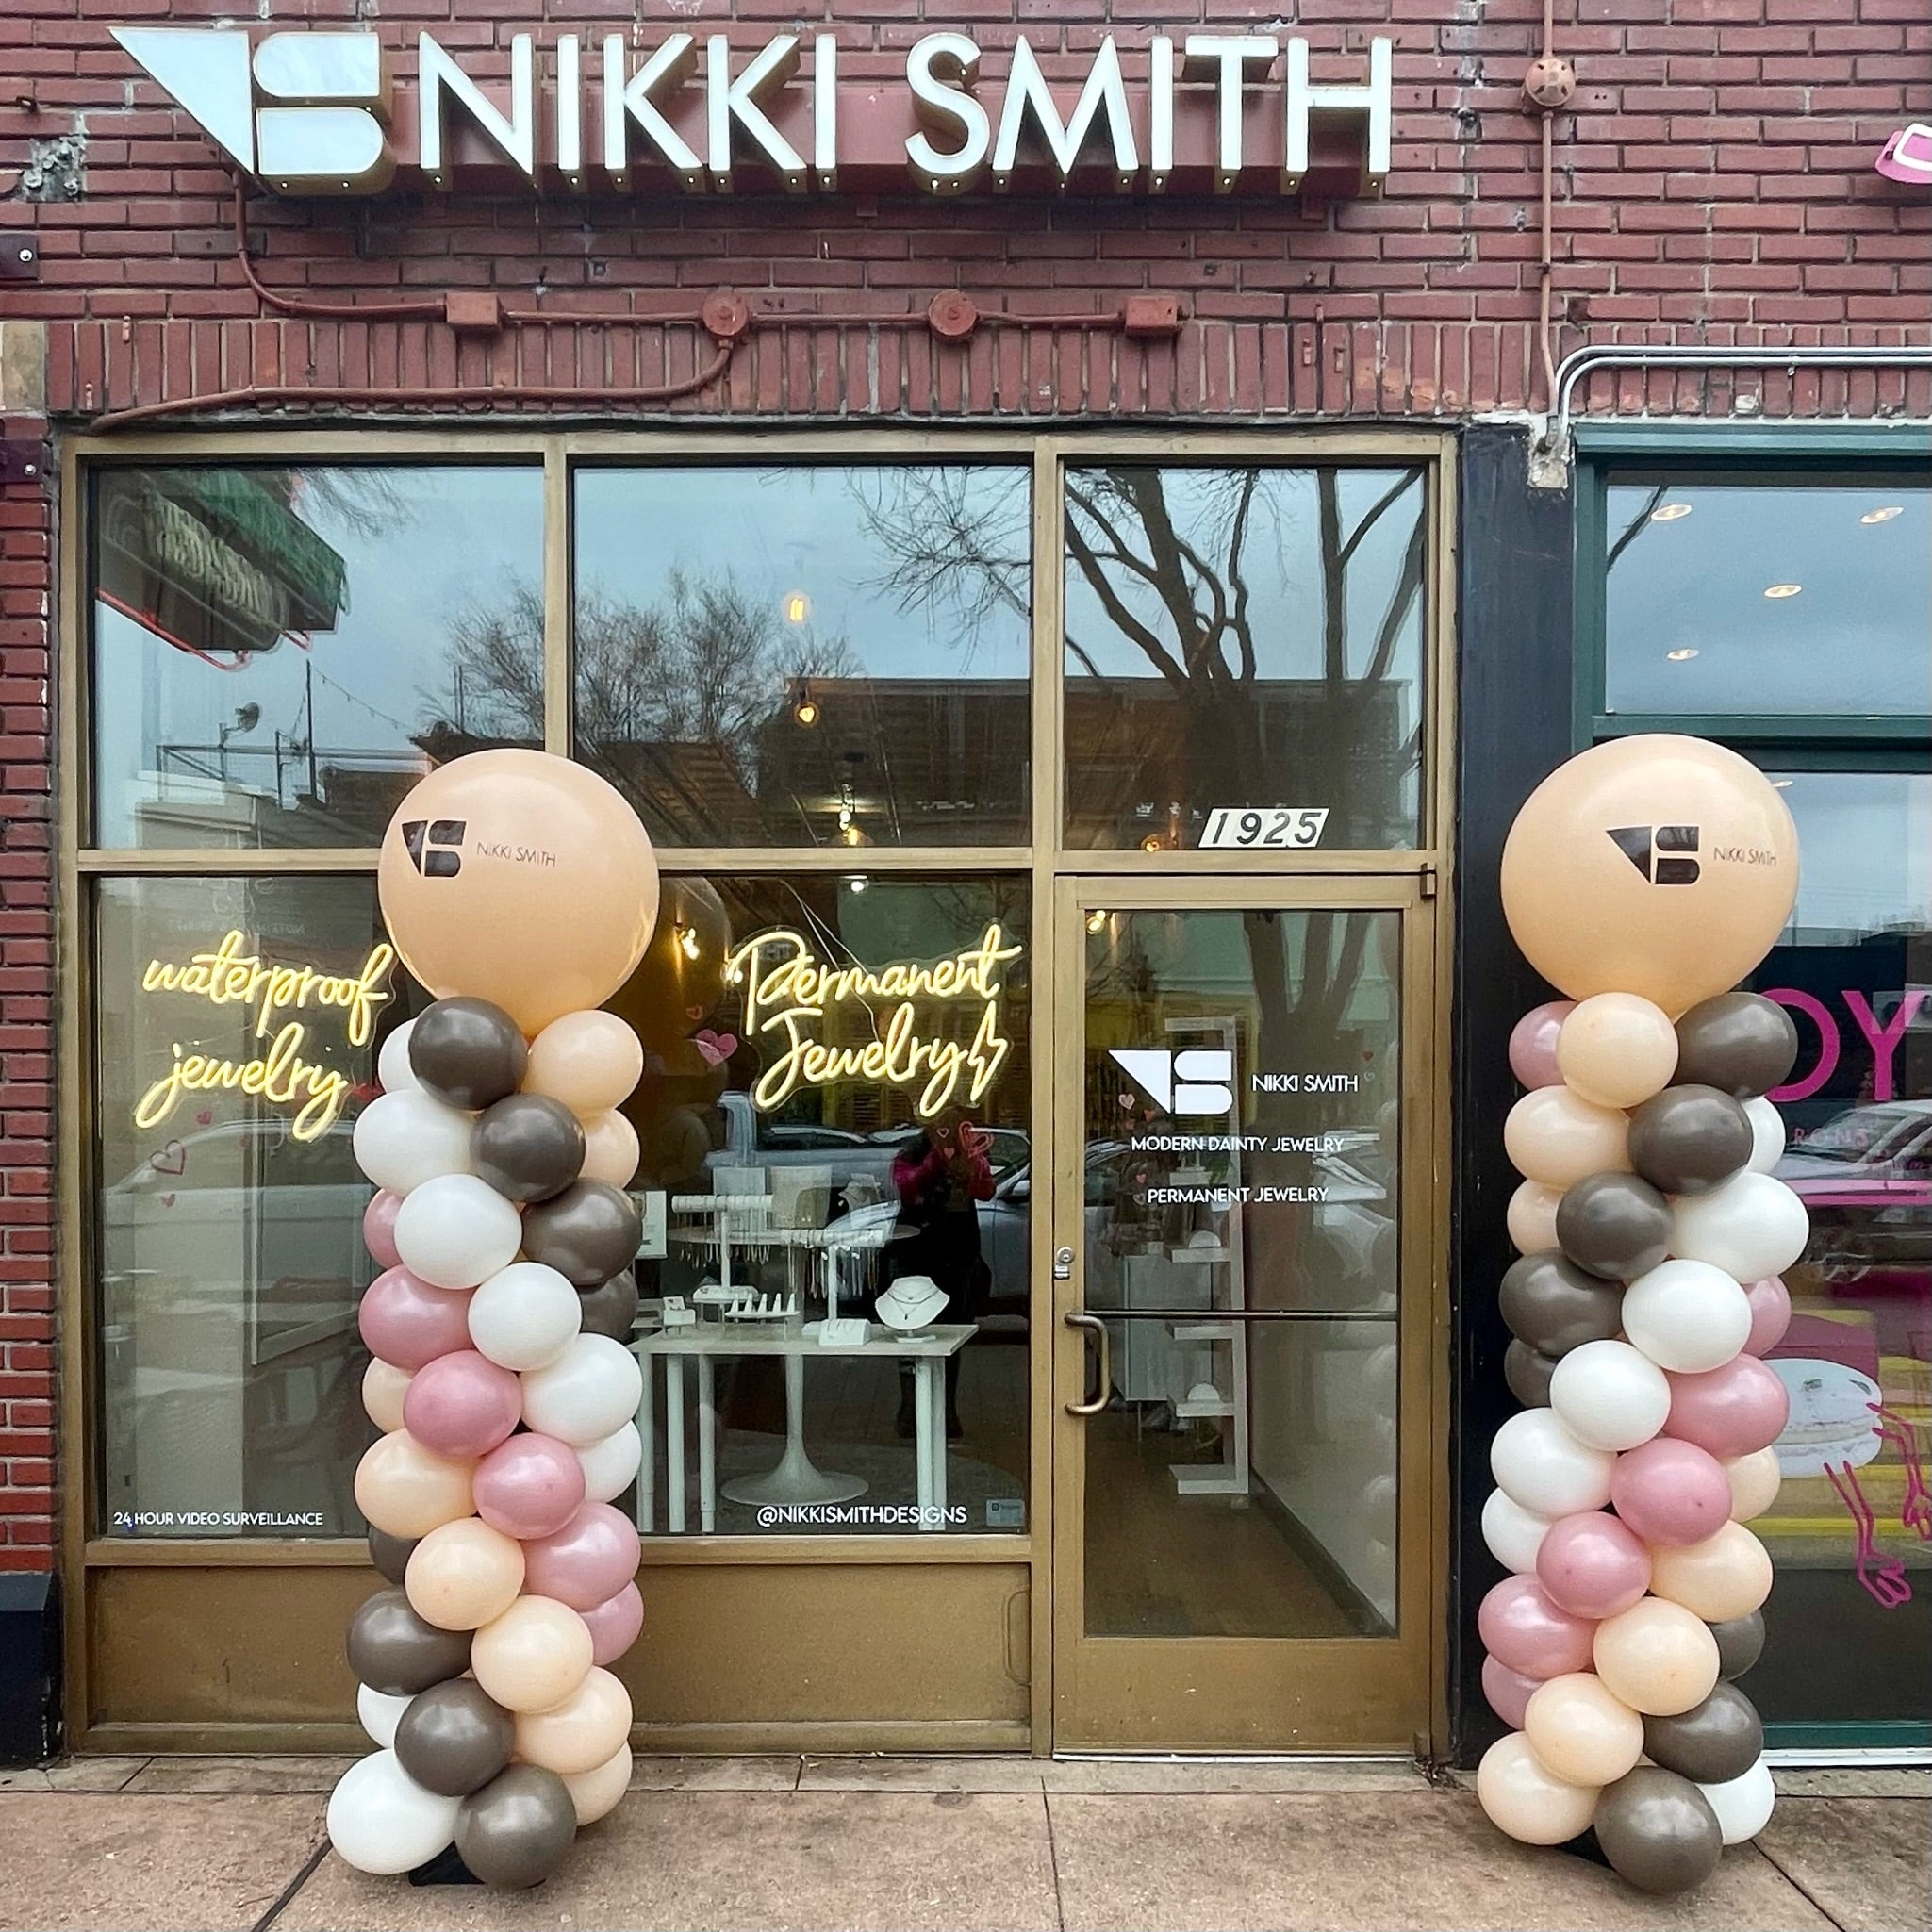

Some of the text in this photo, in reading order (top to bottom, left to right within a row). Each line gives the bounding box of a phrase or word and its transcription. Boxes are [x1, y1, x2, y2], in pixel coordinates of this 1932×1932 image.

[418, 31, 837, 176] NIKKI
[904, 32, 1393, 177] SMITH
[1211, 811, 1322, 845] 1925
[476, 842, 512, 859] NIKKI
[516, 847, 556, 867] SMITH
[1713, 847, 1744, 863] NIKKI
[1748, 848, 1777, 867] SMITH
[141, 929, 394, 1047] waterproof
[732, 923, 1023, 1036] Permanent
[753, 1001, 968, 1118] Jewelry
[135, 1022, 349, 1142] jewelry
[1251, 1075, 1299, 1093] NIKKI
[1303, 1075, 1360, 1093] SMITH
[1131, 1136, 1345, 1153] MODERN DAINTY JEWELRY
[1148, 1186, 1329, 1204] PERMANENT JEWELRY
[113, 1511, 324, 1526] 24 HOUR VIDEO SURVEILLANCE
[756, 1506, 967, 1527] @NIKKISMITHDESIGNS
